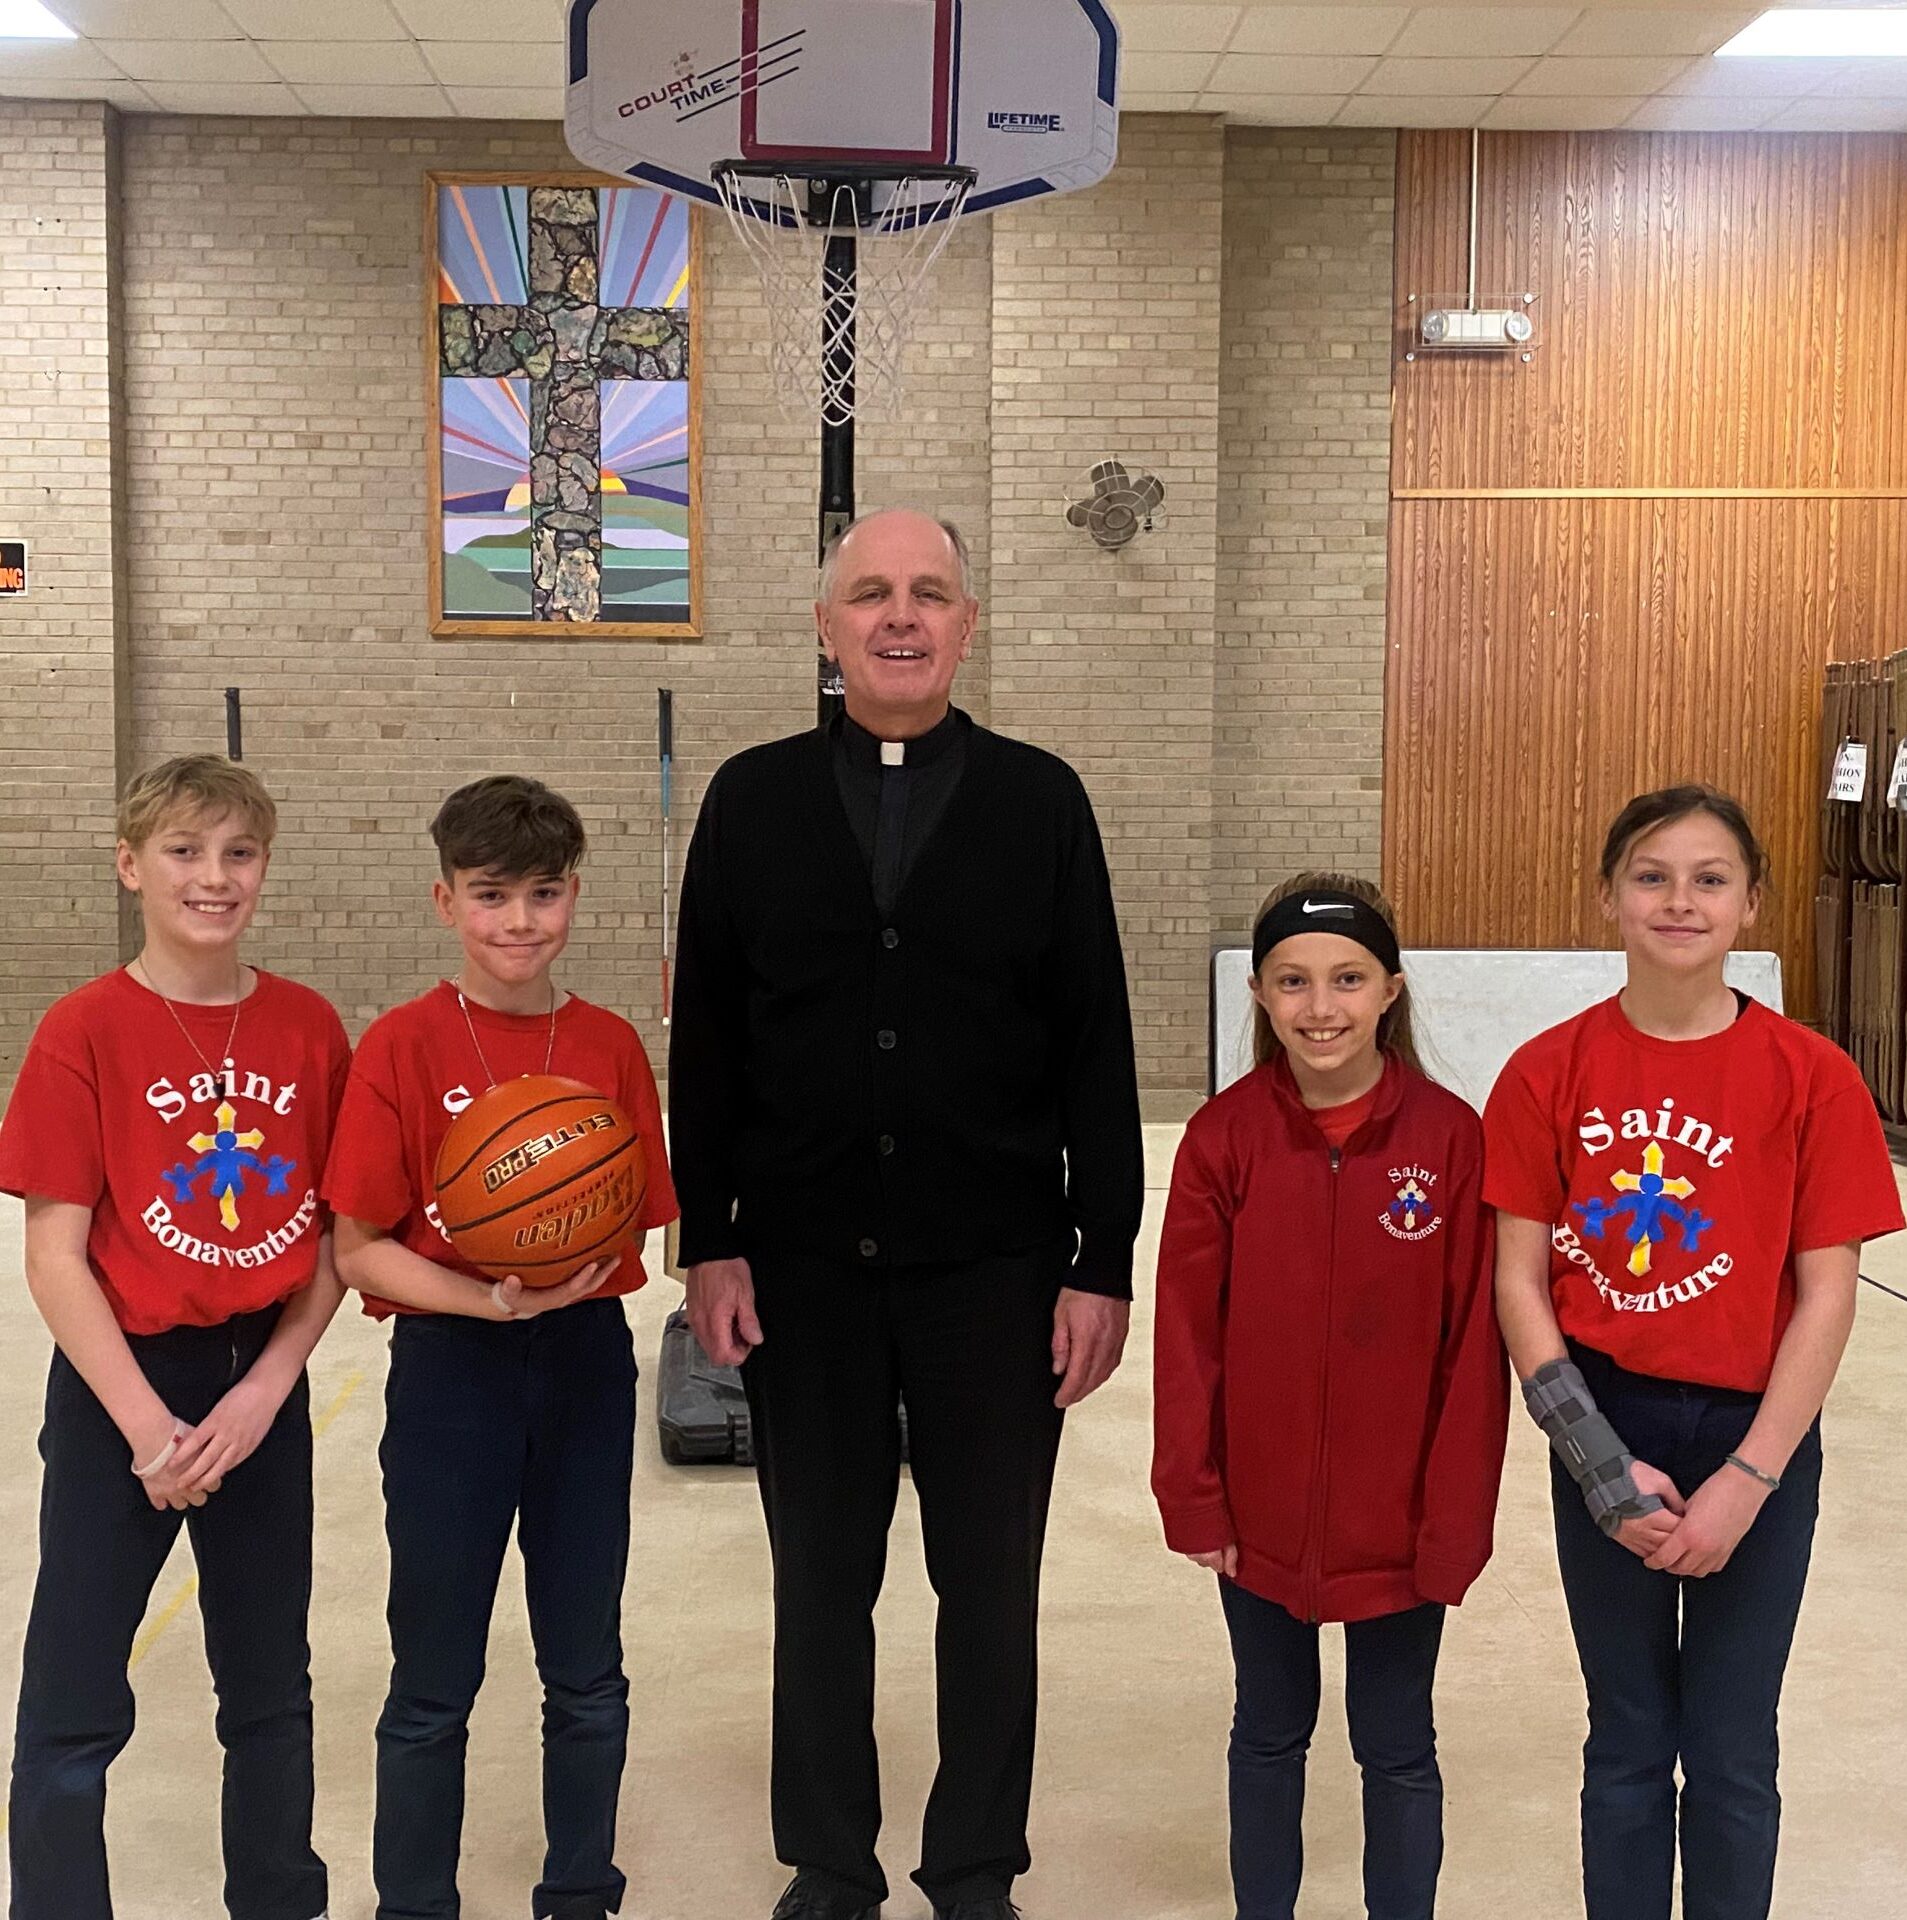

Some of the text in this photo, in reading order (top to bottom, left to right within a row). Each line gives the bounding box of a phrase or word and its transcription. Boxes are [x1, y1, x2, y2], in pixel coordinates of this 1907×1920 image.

[618, 73, 695, 118] COURT
[670, 79, 726, 111] TIME
[988, 112, 1061, 131] LIFETIME
[146, 1057, 297, 1124] Saint
[484, 1112, 617, 1193] ELITE PRO
[1579, 1097, 1734, 1168] Saint
[1387, 1163, 1438, 1187] Saint
[140, 1188, 317, 1269] Bonaventure
[514, 1163, 636, 1250] Baden
[1377, 1211, 1442, 1241] Bonaventure
